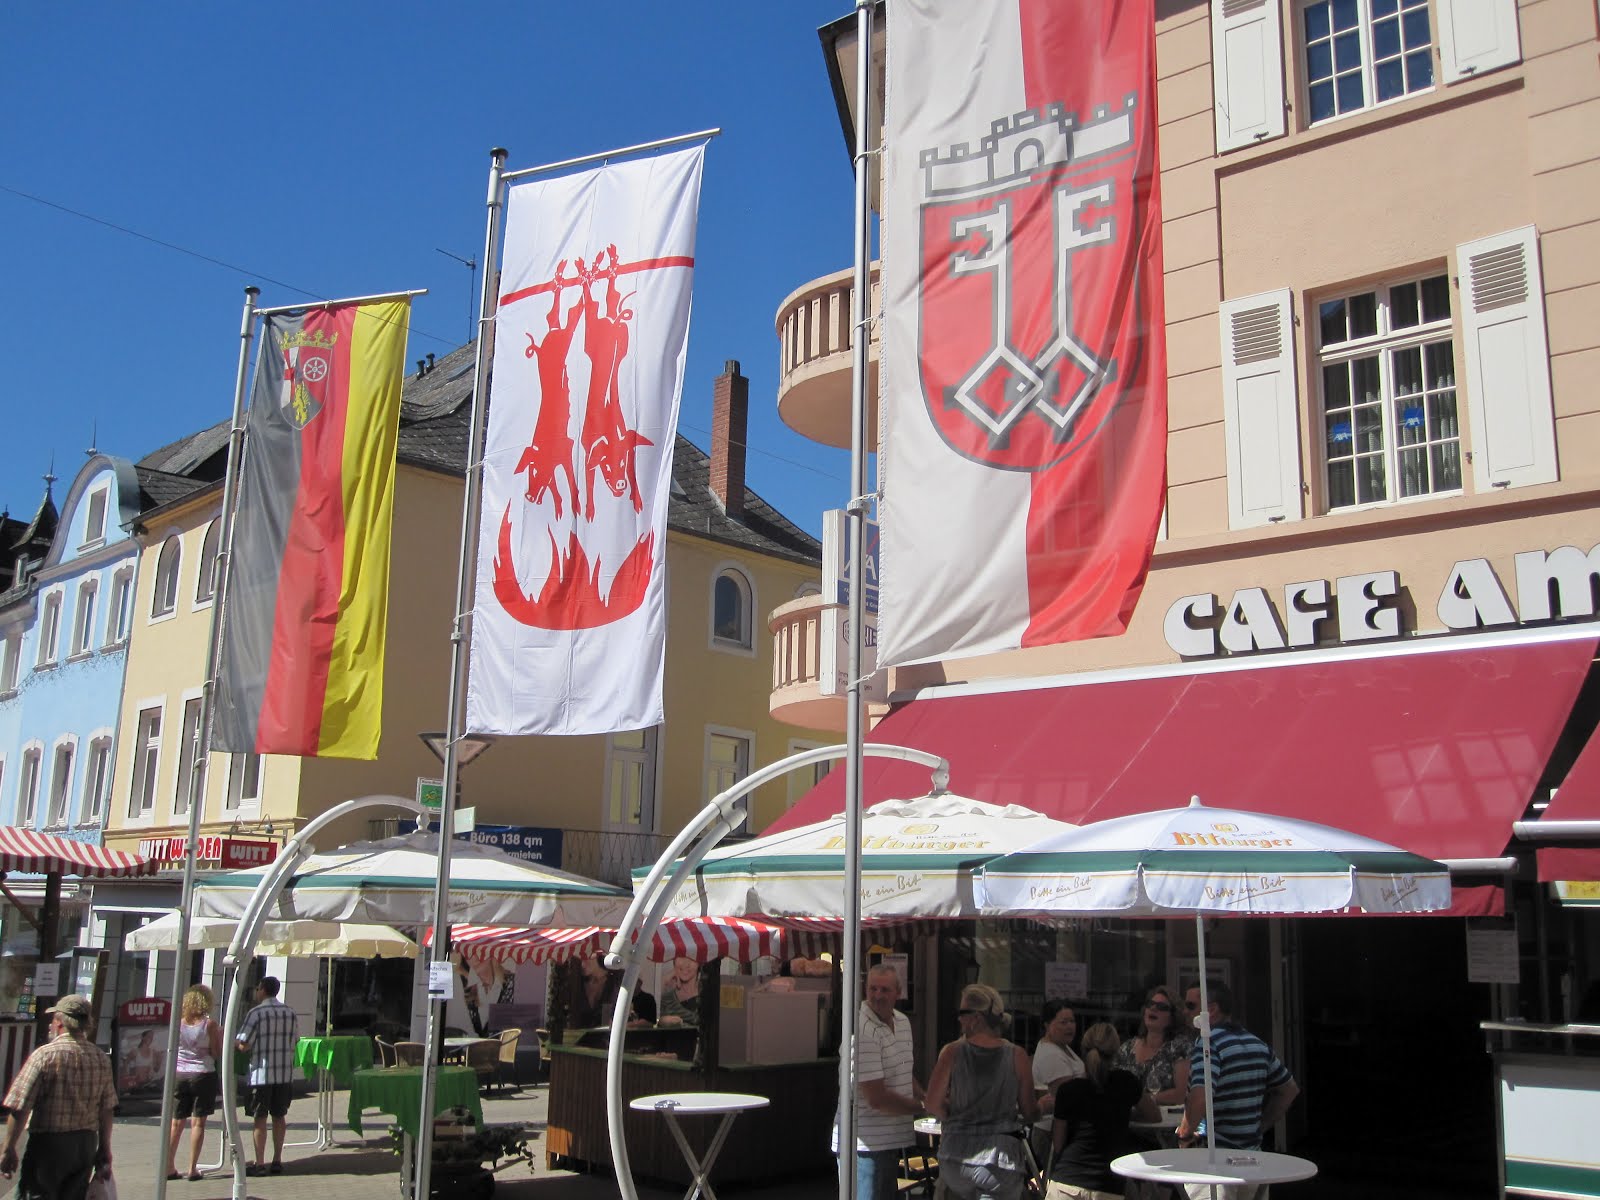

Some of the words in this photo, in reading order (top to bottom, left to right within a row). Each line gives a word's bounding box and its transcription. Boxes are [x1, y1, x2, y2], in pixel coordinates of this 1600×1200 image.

[1163, 570, 1400, 657] CAFE
[470, 832, 498, 844] Büro
[502, 833, 520, 846] 138
[523, 837, 542, 848] qm
[1172, 831, 1292, 848] Bitburger
[139, 839, 169, 860] WITT
[230, 845, 270, 860] WITT
[897, 875, 921, 890] Bit
[1261, 876, 1285, 890] Bit
[128, 1003, 165, 1016] WITT
